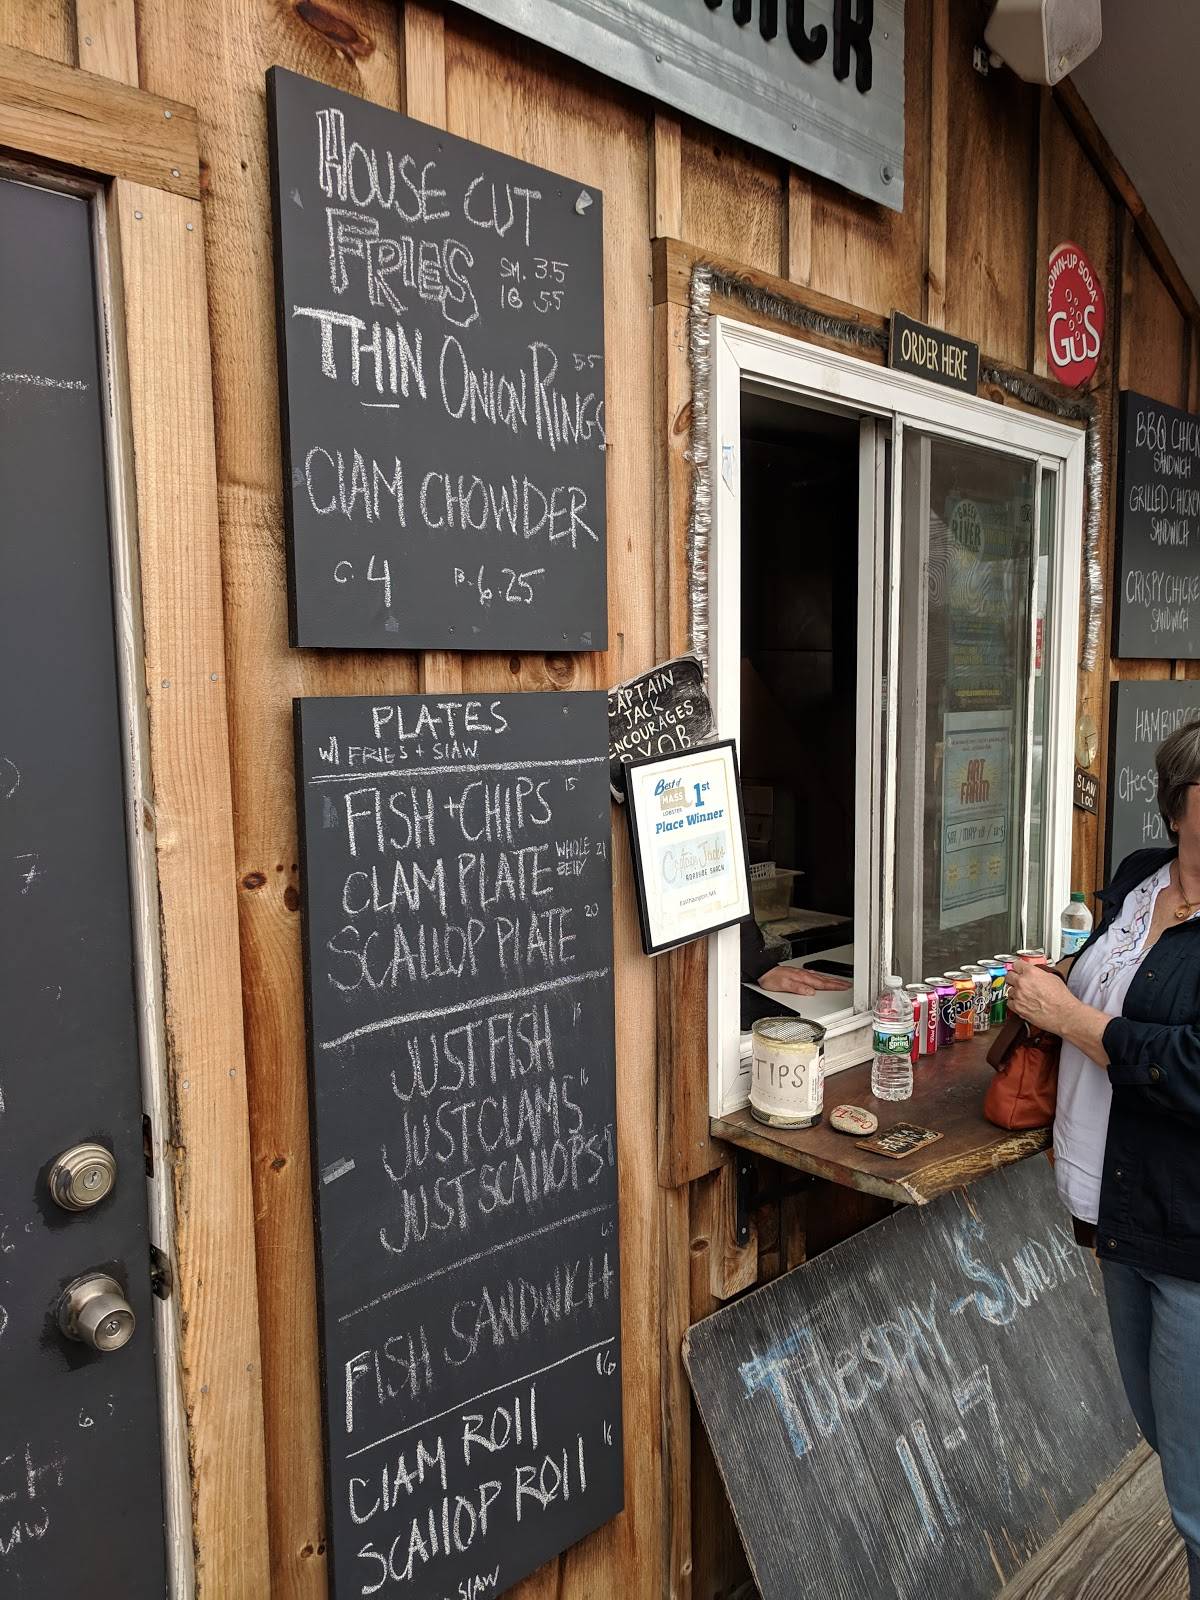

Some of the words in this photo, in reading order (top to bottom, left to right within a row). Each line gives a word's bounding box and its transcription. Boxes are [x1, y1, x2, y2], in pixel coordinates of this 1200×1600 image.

[316, 108, 450, 223] HOUSE
[464, 173, 542, 247] CUT
[325, 207, 480, 328] FRIES
[292, 305, 427, 400] THIN
[439, 335, 528, 434] ONION
[901, 328, 938, 371] ORDER
[941, 343, 968, 381] HERE
[1136, 411, 1167, 452] BBQ
[420, 471, 599, 549] CHOWDER
[1129, 483, 1169, 514] GRILLED
[366, 555, 392, 608] 4
[1126, 570, 1164, 608] CRISPY
[608, 670, 674, 717] CAPTAIN
[623, 696, 664, 730] JACK
[372, 701, 509, 741] PLATES
[348, 744, 409, 766] FRIES
[654, 778, 675, 797] Best
[661, 791, 684, 805] MASS
[693, 780, 711, 808] 1st
[1076, 774, 1097, 798] SLAW
[345, 785, 436, 857] FISH
[655, 819, 684, 835] Place
[686, 808, 725, 826] Winner
[342, 857, 447, 917] CLAM
[458, 844, 554, 914] PLATE
[495, 905, 577, 971] PLATE
[928, 1000, 937, 1030] Coke
[390, 1020, 483, 1101] JUST
[487, 1002, 555, 1085] FISH
[888, 1040, 909, 1050] Spring
[753, 1057, 806, 1089] TIPS
[381, 1101, 477, 1181] JUST
[379, 1168, 477, 1255] JUST
[953, 1219, 1101, 1326] SUNDAY
[345, 1324, 434, 1434] FISH
[444, 1252, 614, 1366] SANDWICH
[596, 1351, 617, 1376] 16
